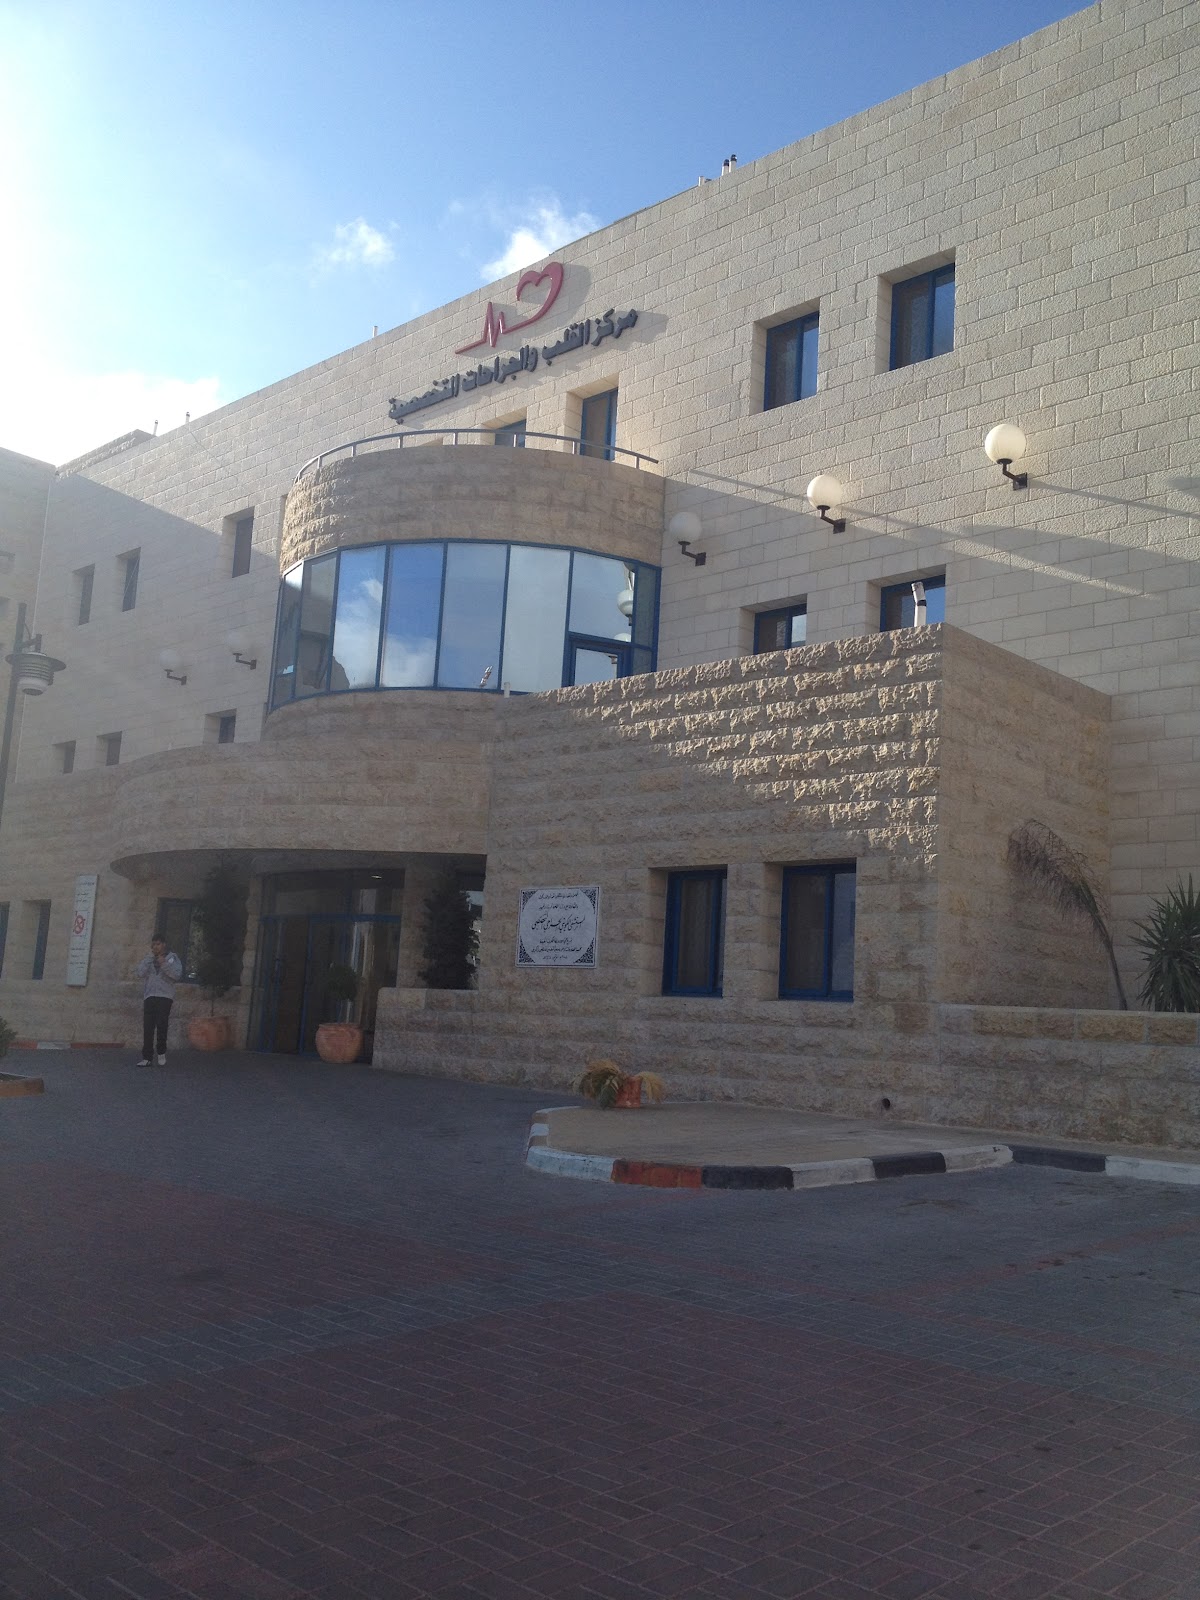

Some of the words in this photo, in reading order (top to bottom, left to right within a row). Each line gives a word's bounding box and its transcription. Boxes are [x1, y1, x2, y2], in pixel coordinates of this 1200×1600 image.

[542, 319, 591, 366] القلب
[591, 308, 638, 346] مركز
[461, 345, 539, 391] والجراحات
[388, 373, 461, 425] التخصصية
